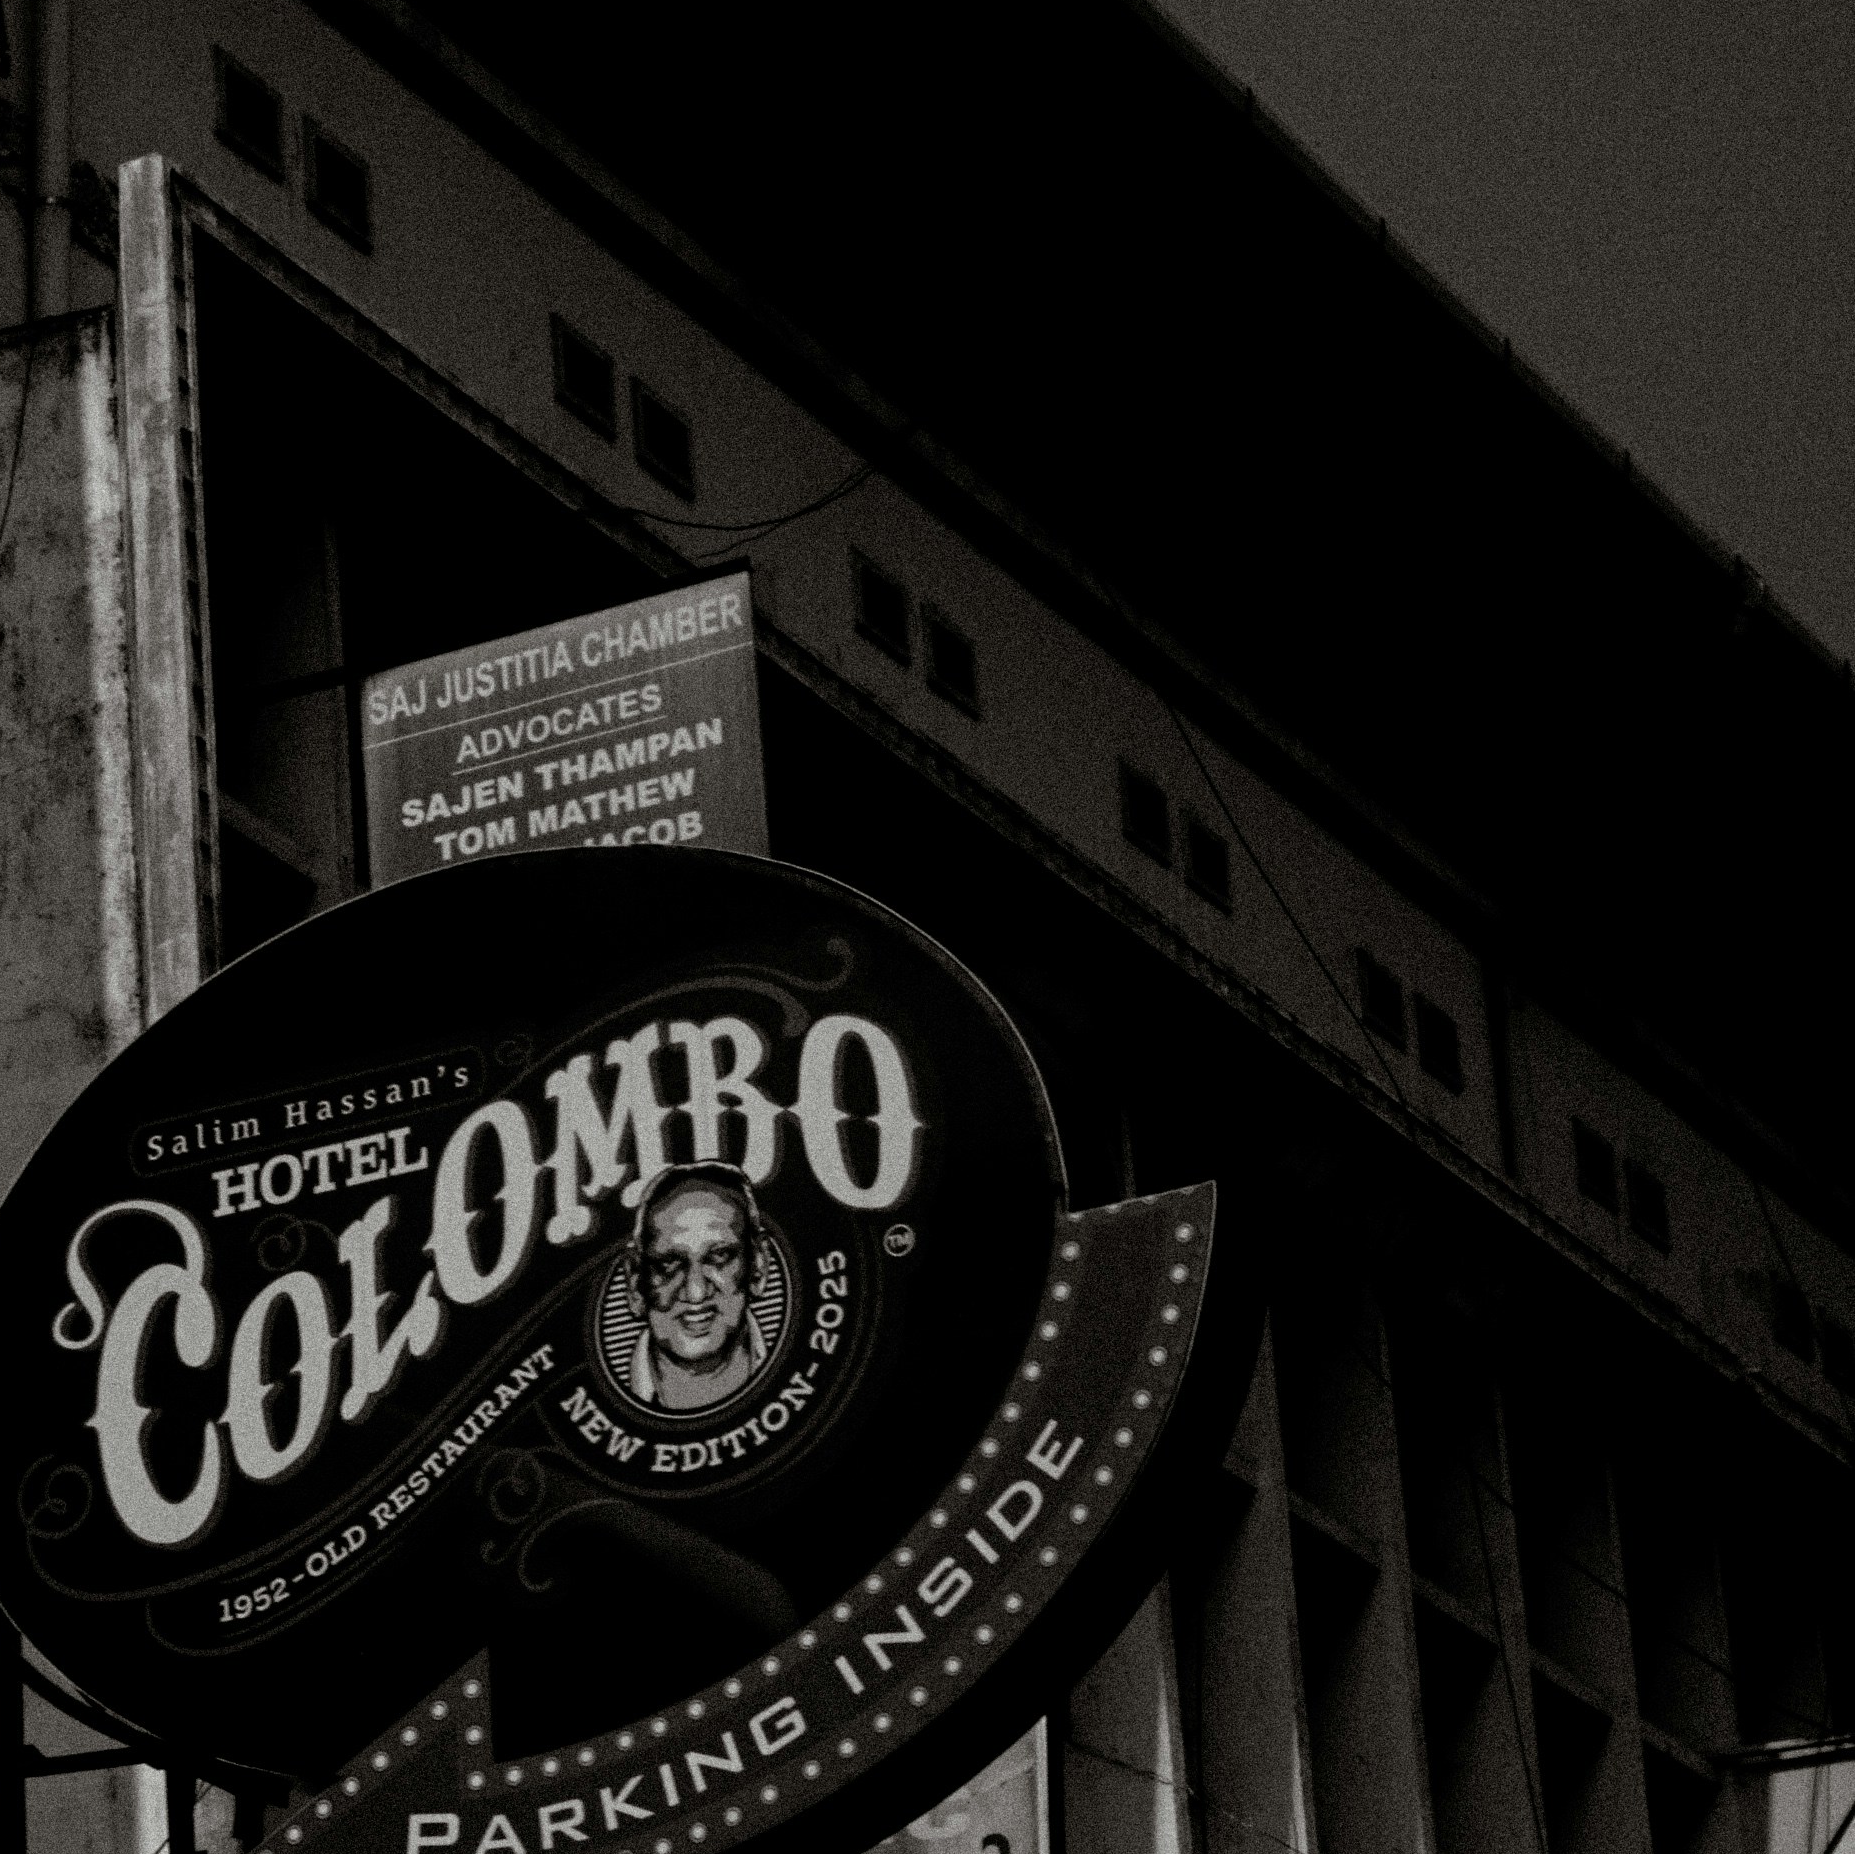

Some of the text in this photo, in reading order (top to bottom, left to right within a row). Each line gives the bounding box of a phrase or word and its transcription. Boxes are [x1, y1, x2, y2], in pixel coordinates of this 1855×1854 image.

[367, 592, 744, 726] SAJ JUSTITIA CHAMBER
[401, 717, 724, 828] SAJEN THAMPAN
[455, 683, 663, 765] ADVOCATES
[433, 768, 697, 862] TOM MATHEW
[145, 1063, 473, 1163] Salim Hassan's
[210, 1124, 430, 1219] HOTEL
[51, 1013, 930, 1546] COLOMBO
[558, 1386, 647, 1469] NEW
[809, 1248, 849, 1357] 2025
[368, 1342, 559, 1531] RESTAURANT
[833, 1418, 1085, 1696] INSIDE
